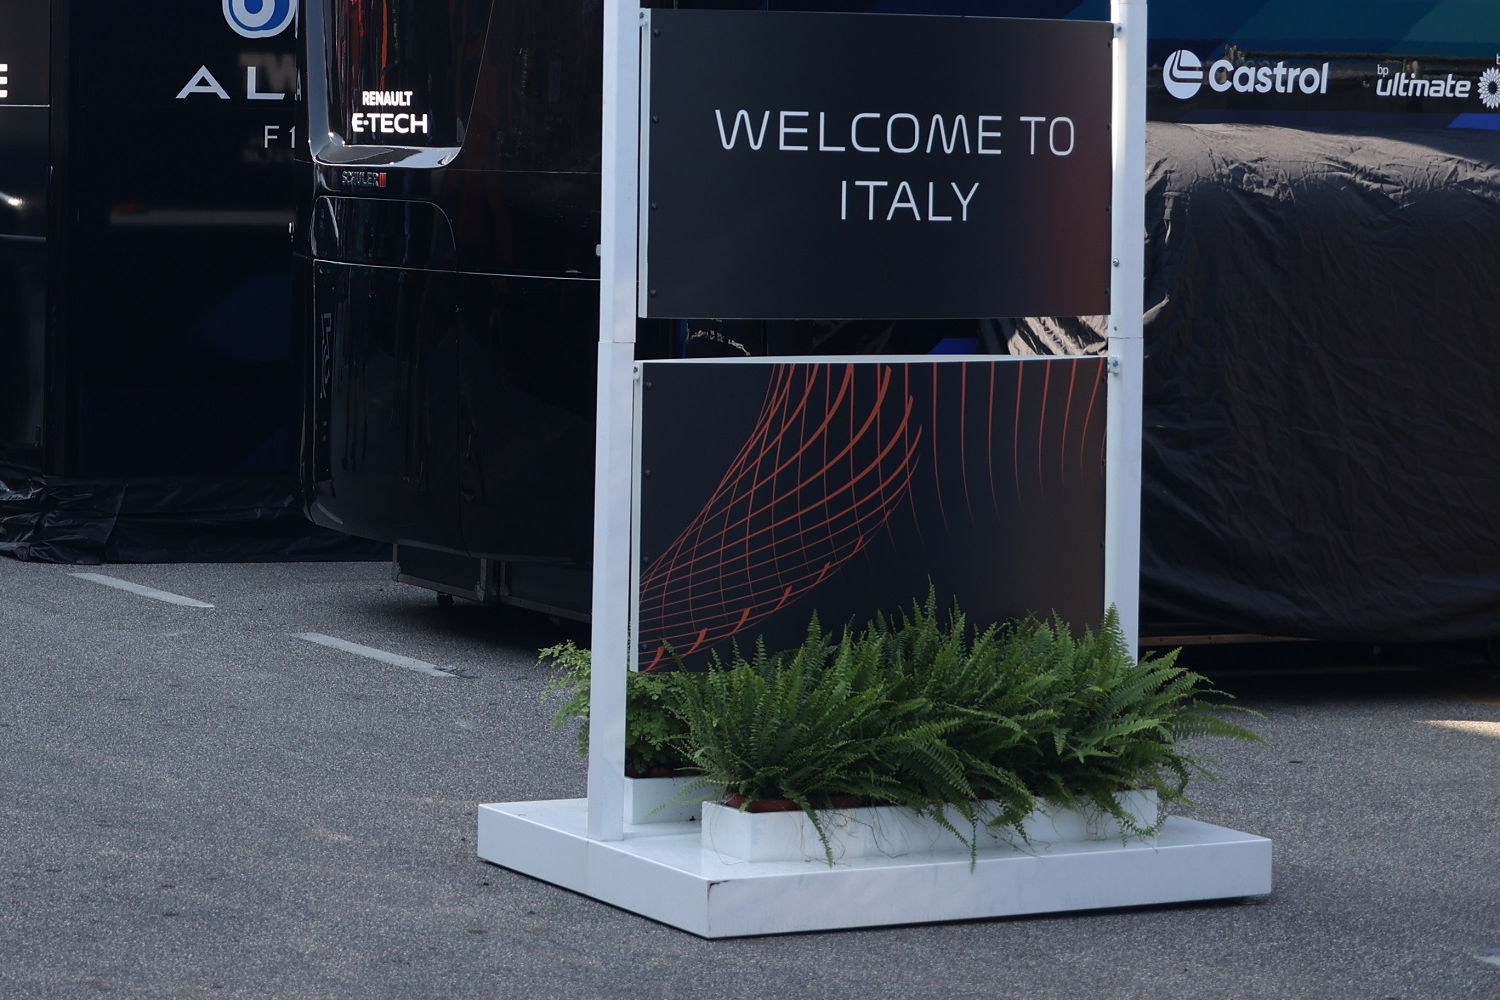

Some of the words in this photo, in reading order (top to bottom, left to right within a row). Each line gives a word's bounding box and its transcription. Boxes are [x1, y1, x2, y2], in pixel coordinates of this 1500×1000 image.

[1208, 60, 1330, 95] Castrol
[1376, 72, 1471, 98] ultimate
[1377, 64, 1389, 77] bp
[362, 90, 413, 106] RENAULT
[715, 109, 1003, 155] WELCOME
[1019, 116, 1075, 156] TO
[841, 180, 979, 222] ITALY
